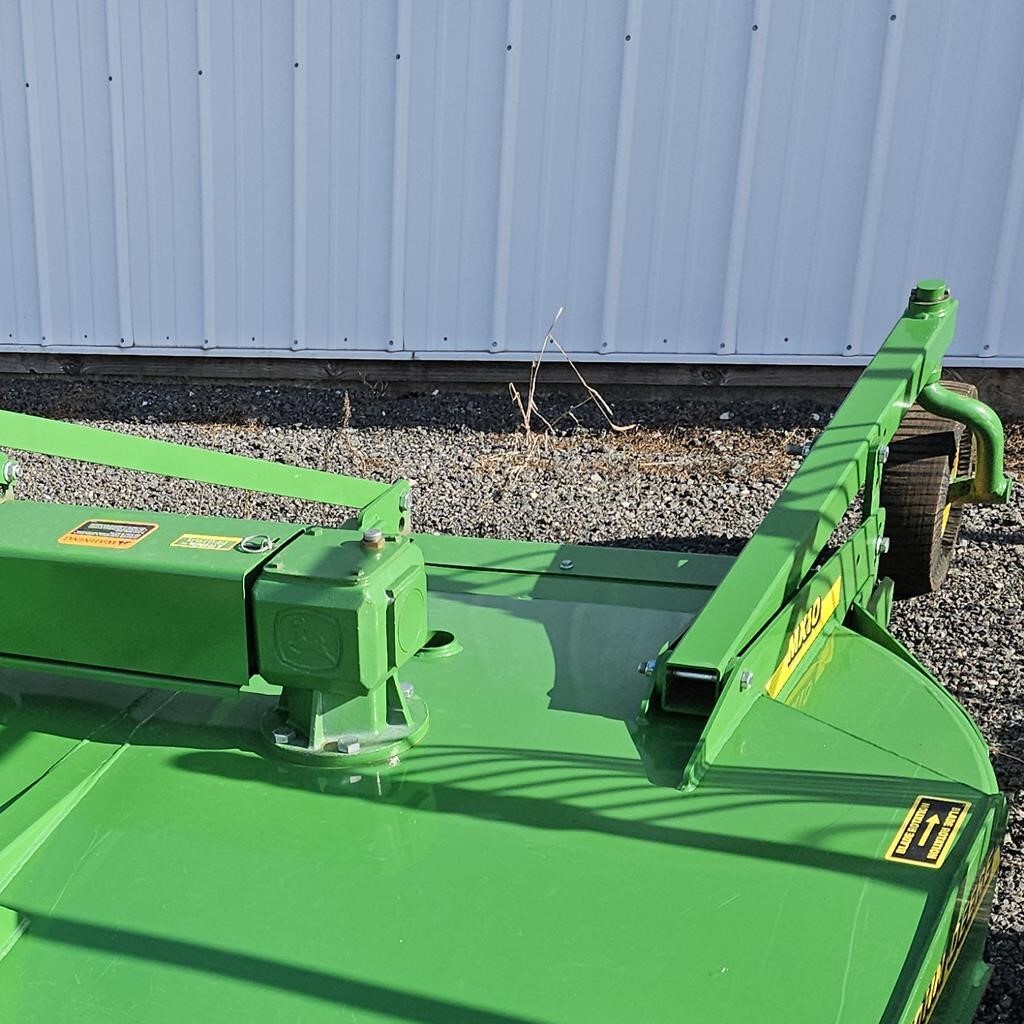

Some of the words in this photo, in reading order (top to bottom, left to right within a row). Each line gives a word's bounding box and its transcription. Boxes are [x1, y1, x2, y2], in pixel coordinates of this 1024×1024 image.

[788, 595, 822, 667] MX10
[895, 831, 915, 855] BLADE
[907, 802, 931, 833] ROTATION
[943, 807, 962, 828] BLADE
[926, 827, 951, 860] ROTATION
